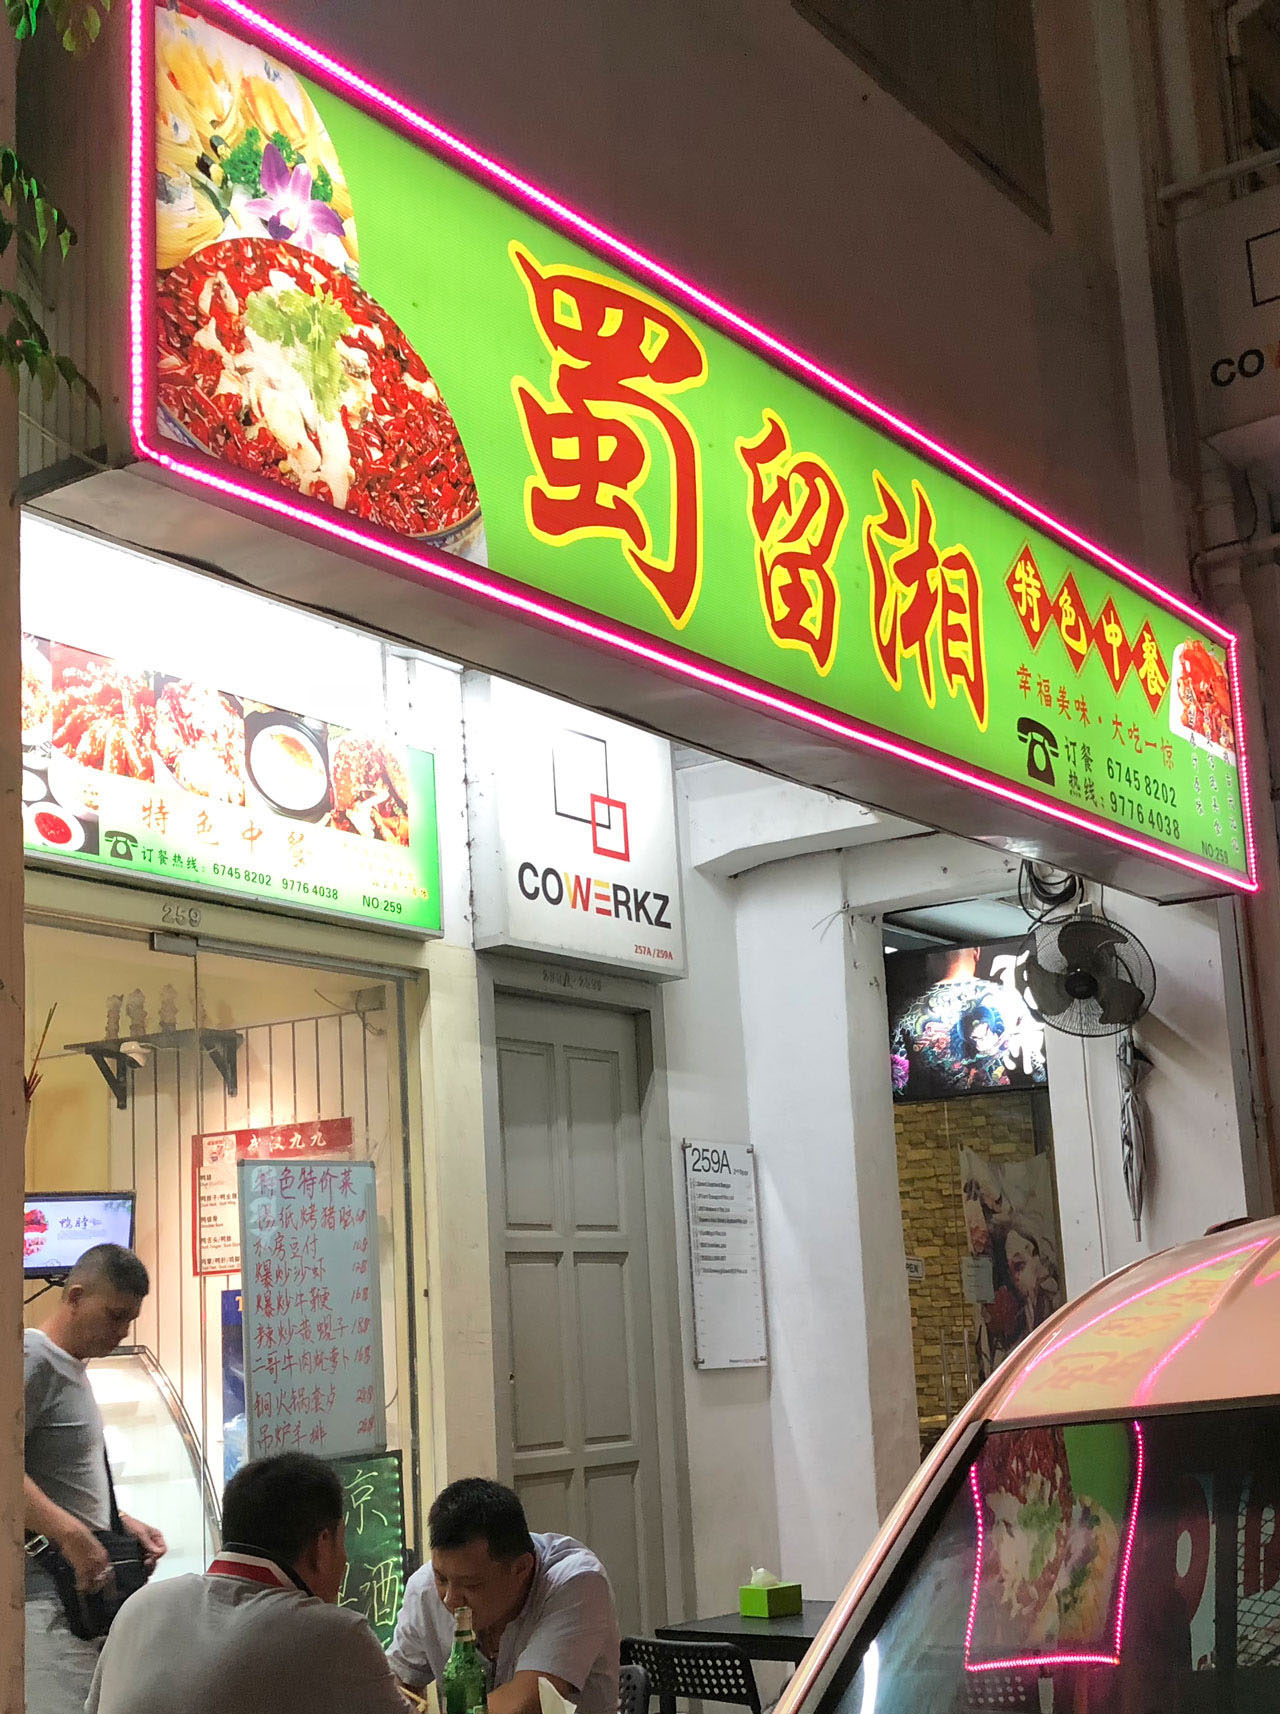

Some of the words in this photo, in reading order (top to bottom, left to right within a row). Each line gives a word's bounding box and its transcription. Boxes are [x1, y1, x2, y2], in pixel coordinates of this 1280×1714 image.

[508, 239, 989, 733] 蜀留湘
[1012, 559, 1168, 696] 特色中餐
[1064, 736, 1094, 773] 订餐
[517, 861, 672, 930] COWERKZ
[161, 902, 201, 928] 259
[691, 1147, 732, 1175] 259A
[906, 1263, 918, 1273] PEN
